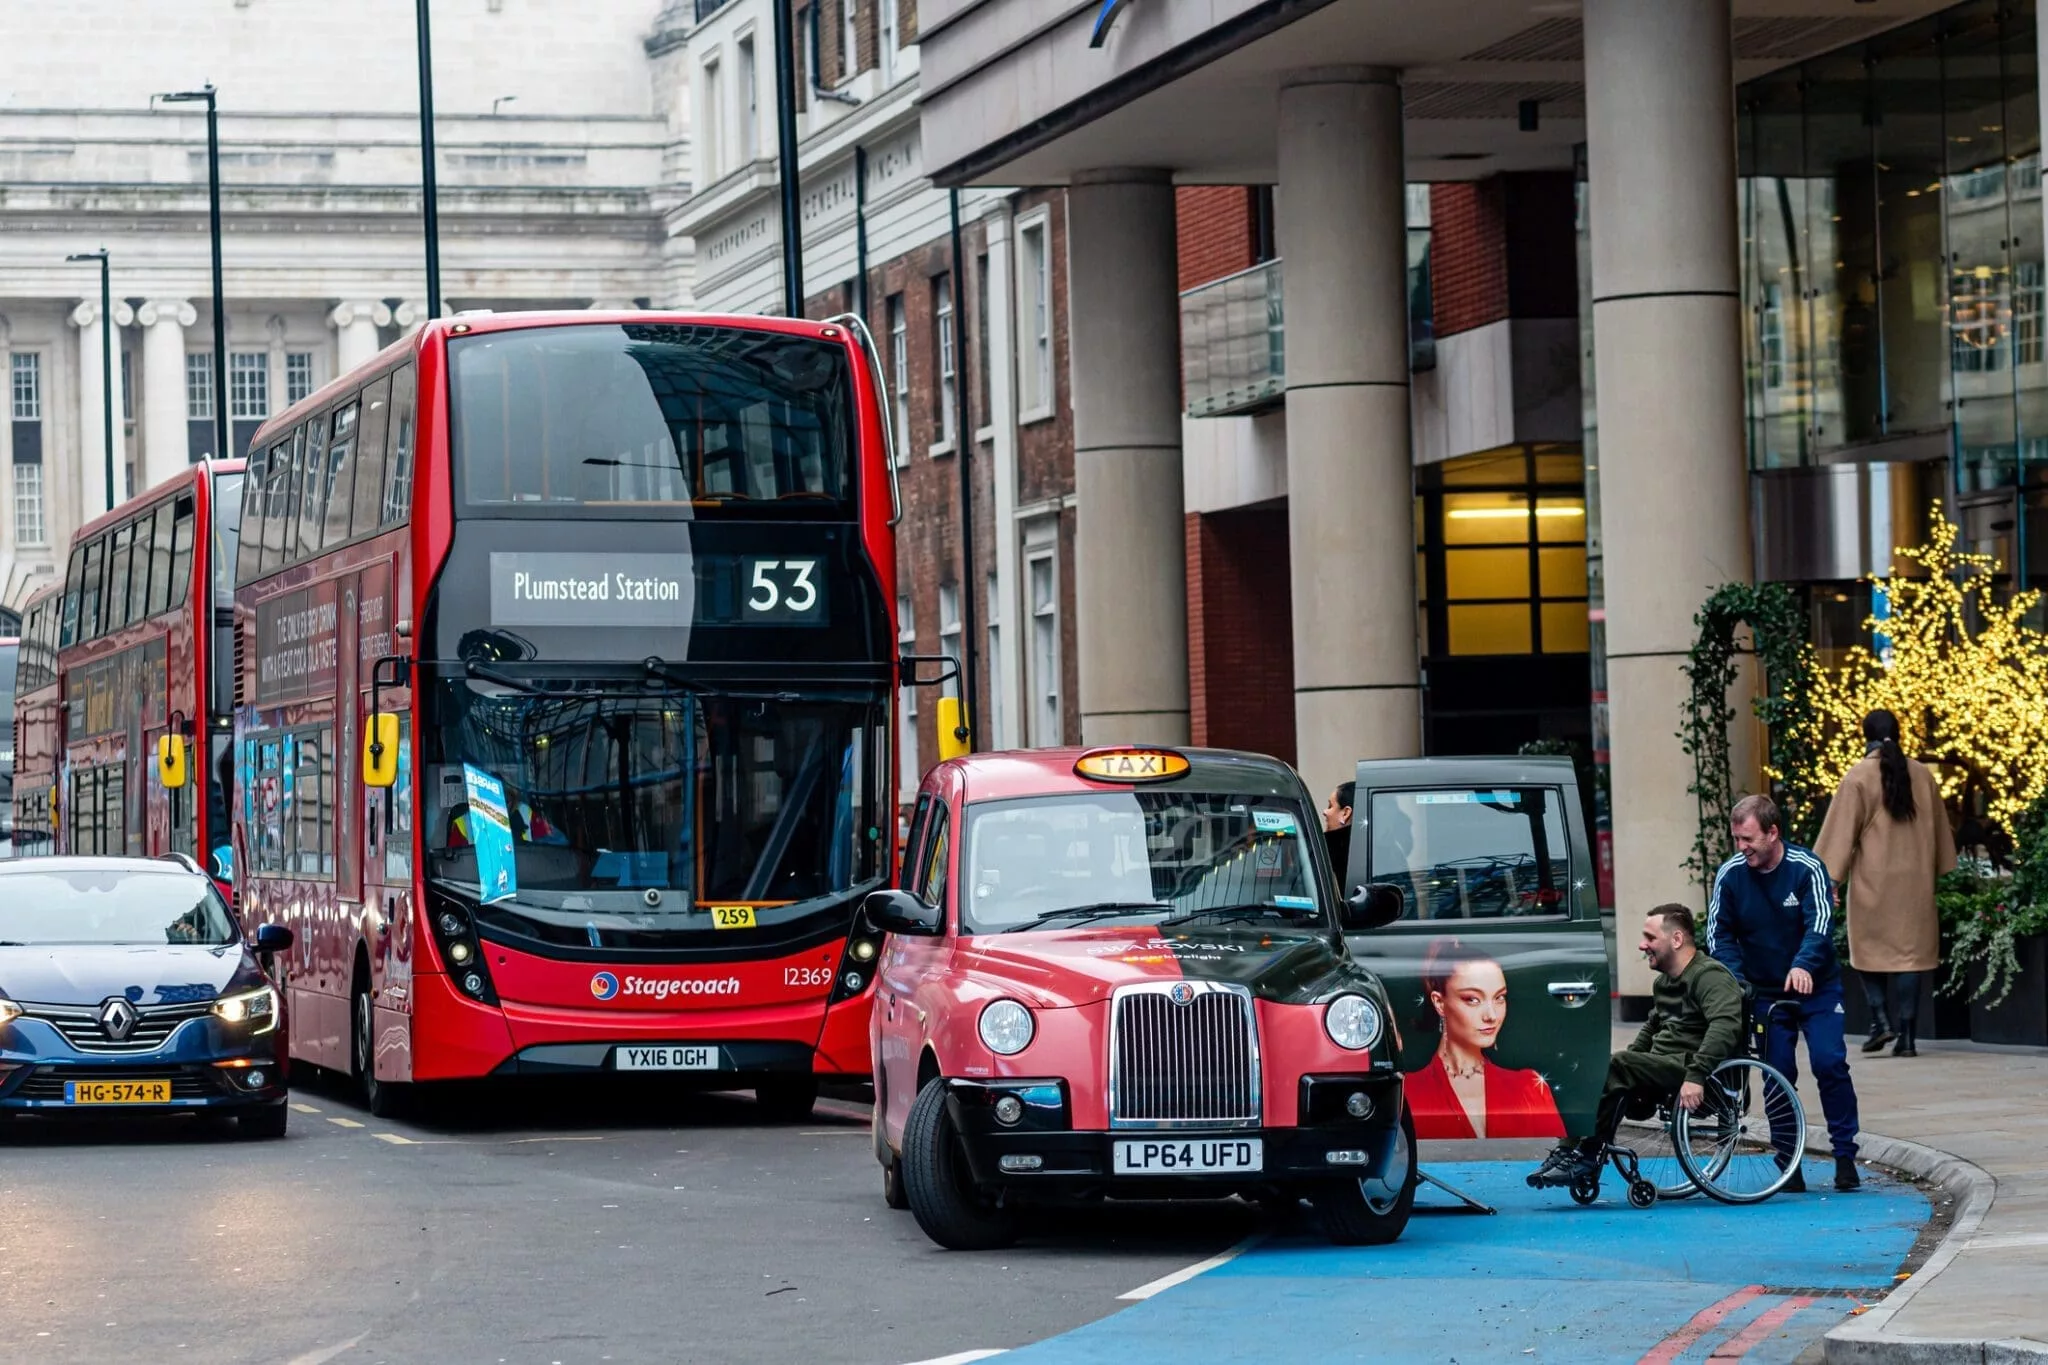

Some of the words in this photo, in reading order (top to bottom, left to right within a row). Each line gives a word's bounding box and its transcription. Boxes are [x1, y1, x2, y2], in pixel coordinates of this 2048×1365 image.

[514, 572, 609, 601] Plumstead
[616, 573, 680, 601] Station
[748, 560, 817, 612] 53
[1101, 756, 1167, 773] TAXI
[717, 909, 749, 925] 259
[1087, 943, 1245, 954] SWAROVSKI
[784, 967, 832, 985] 12369
[623, 976, 740, 1000] Stagecoach
[628, 1050, 668, 1066] YX16
[672, 1049, 707, 1066] OGH
[79, 1084, 165, 1101] HG-574-R
[1126, 1144, 1194, 1168] LP64
[1201, 1142, 1251, 1167] UFD
